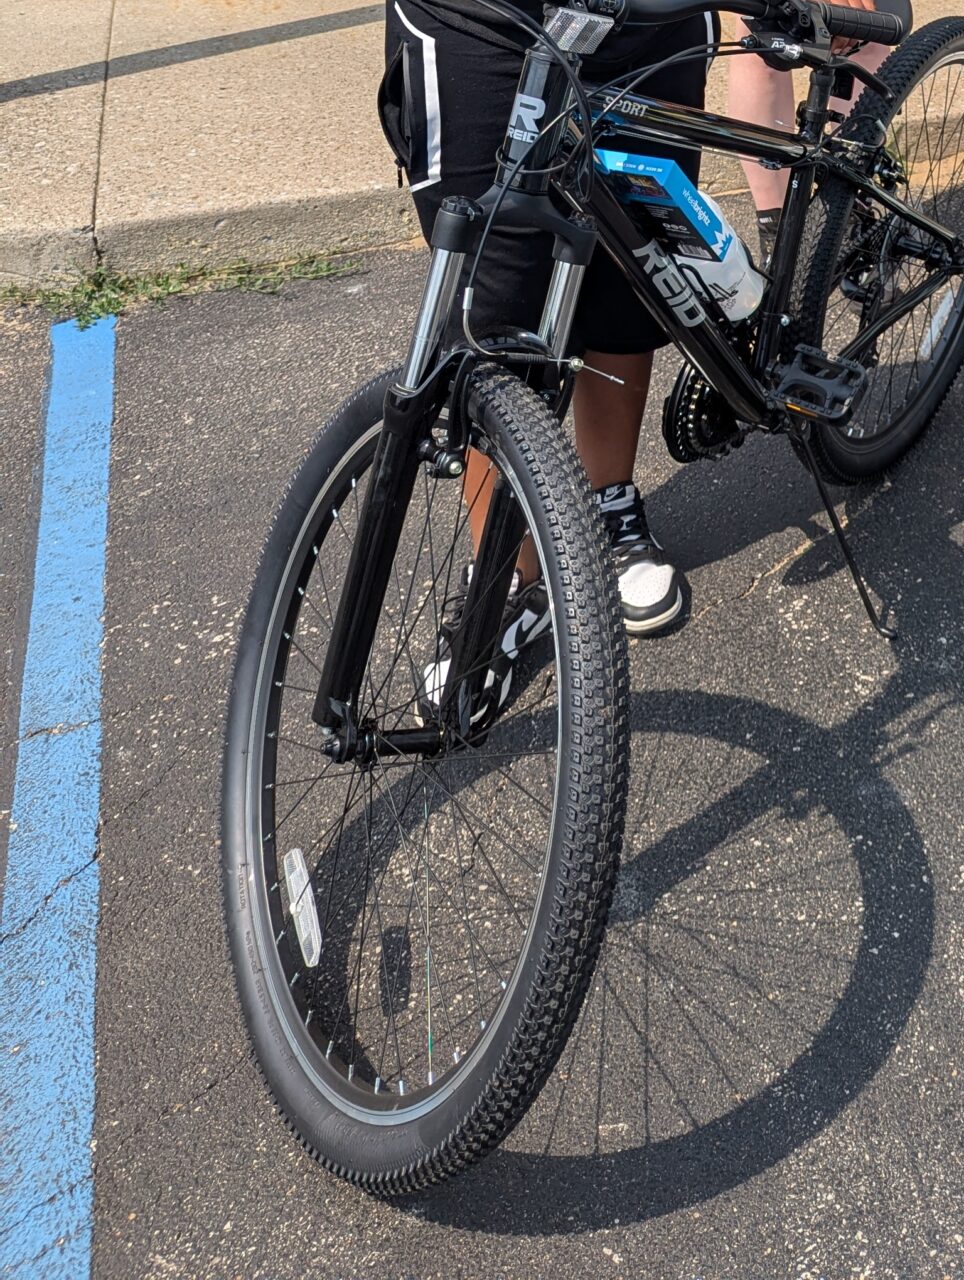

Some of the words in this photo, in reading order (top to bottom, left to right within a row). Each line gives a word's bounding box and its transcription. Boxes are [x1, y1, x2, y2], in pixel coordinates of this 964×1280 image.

[603, 96, 649, 117] SPORT
[507, 128, 536, 143] REID
[632, 238, 706, 328] REID
